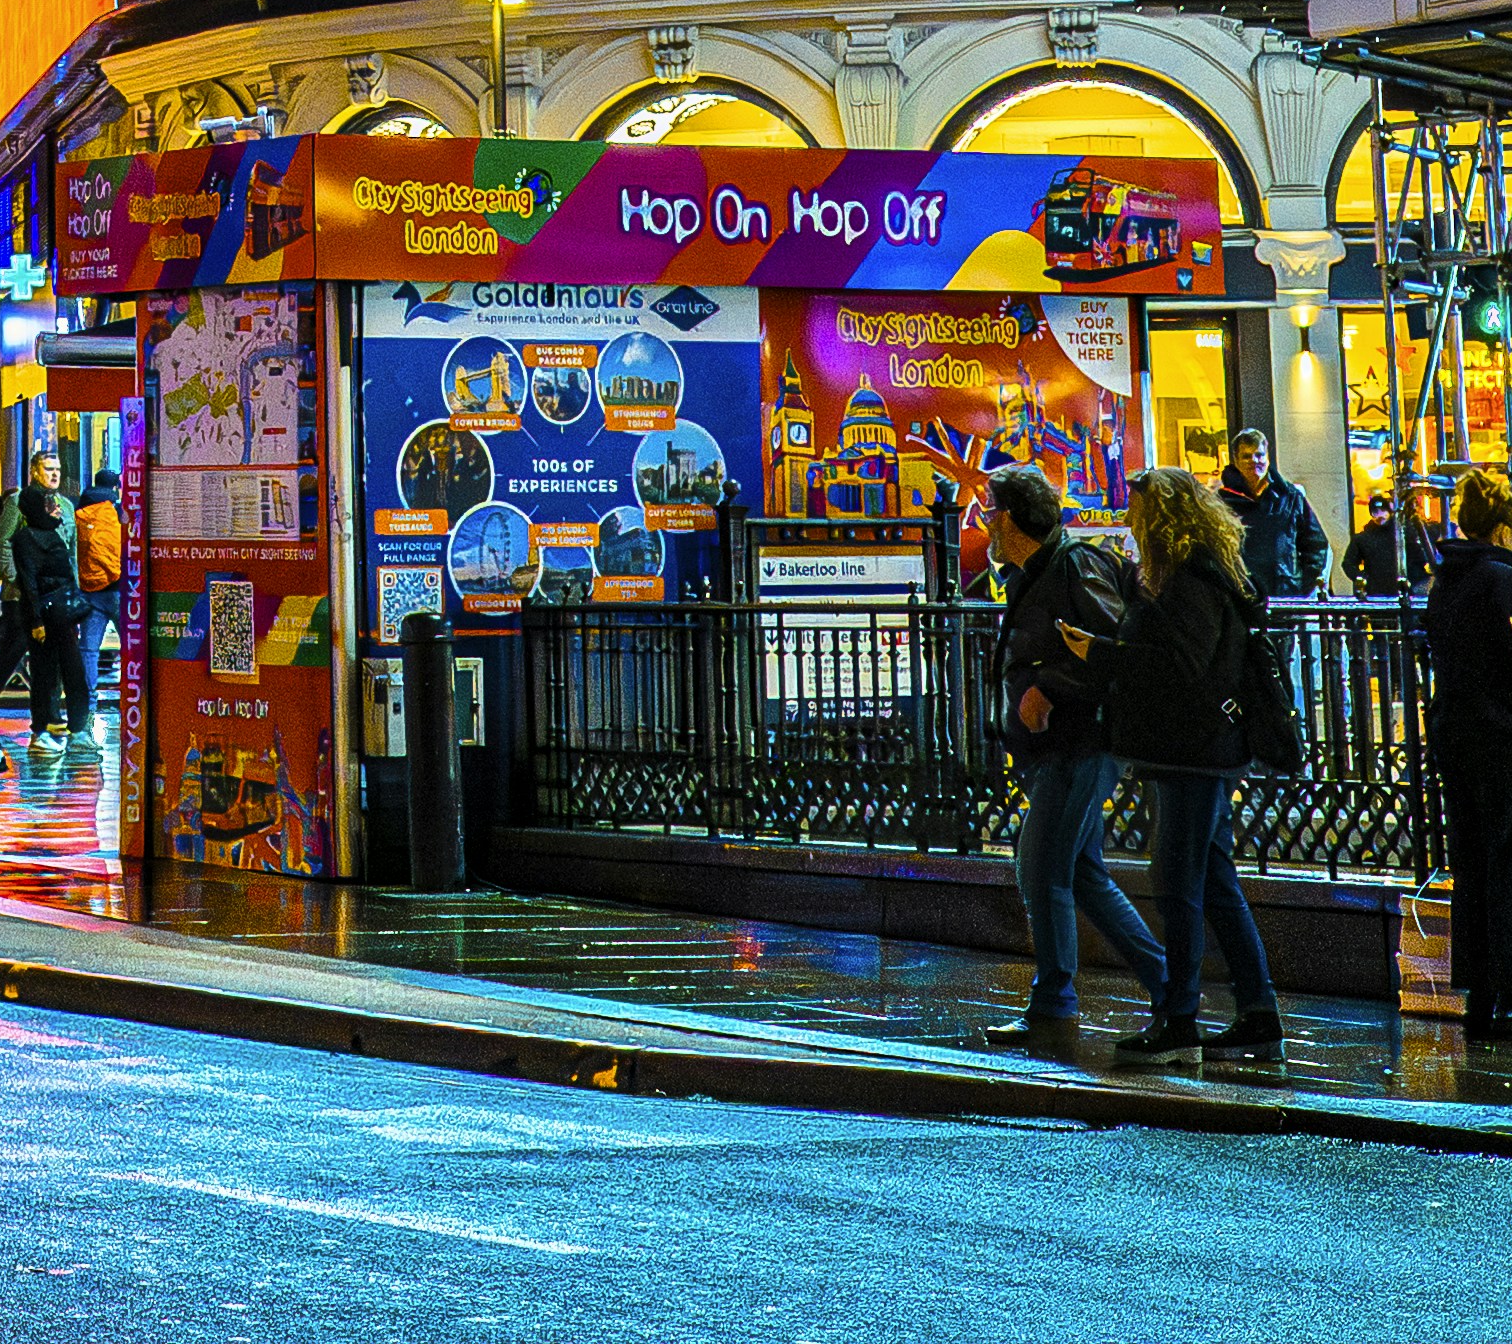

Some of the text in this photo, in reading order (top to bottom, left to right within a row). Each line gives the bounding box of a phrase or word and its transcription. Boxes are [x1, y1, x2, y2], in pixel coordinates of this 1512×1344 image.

[68, 173, 112, 203] Hop On
[68, 209, 112, 238] Hop Off
[619, 188, 944, 245] Hop On Hop Off
[405, 219, 499, 255] London
[1081, 301, 1109, 313] BUY
[539, 313, 579, 325] London
[1075, 316, 1114, 330] YOUR
[1067, 332, 1124, 345] TICKETS
[1077, 348, 1114, 361] HERE
[890, 354, 984, 389] London
[455, 418, 484, 428] TOWER
[532, 459, 595, 473] 100s OF
[508, 479, 618, 494] EXPERIENCES
[217, 548, 240, 560] WITH
[240, 548, 259, 560] CITY
[378, 542, 442, 553] SCAN FOR OUR
[383, 553, 406, 563] FULL
[779, 561, 866, 577] Bakerloo line
[125, 517, 141, 650] TICKETS
[125, 660, 141, 752] YOUR
[125, 755, 141, 824] BUY
